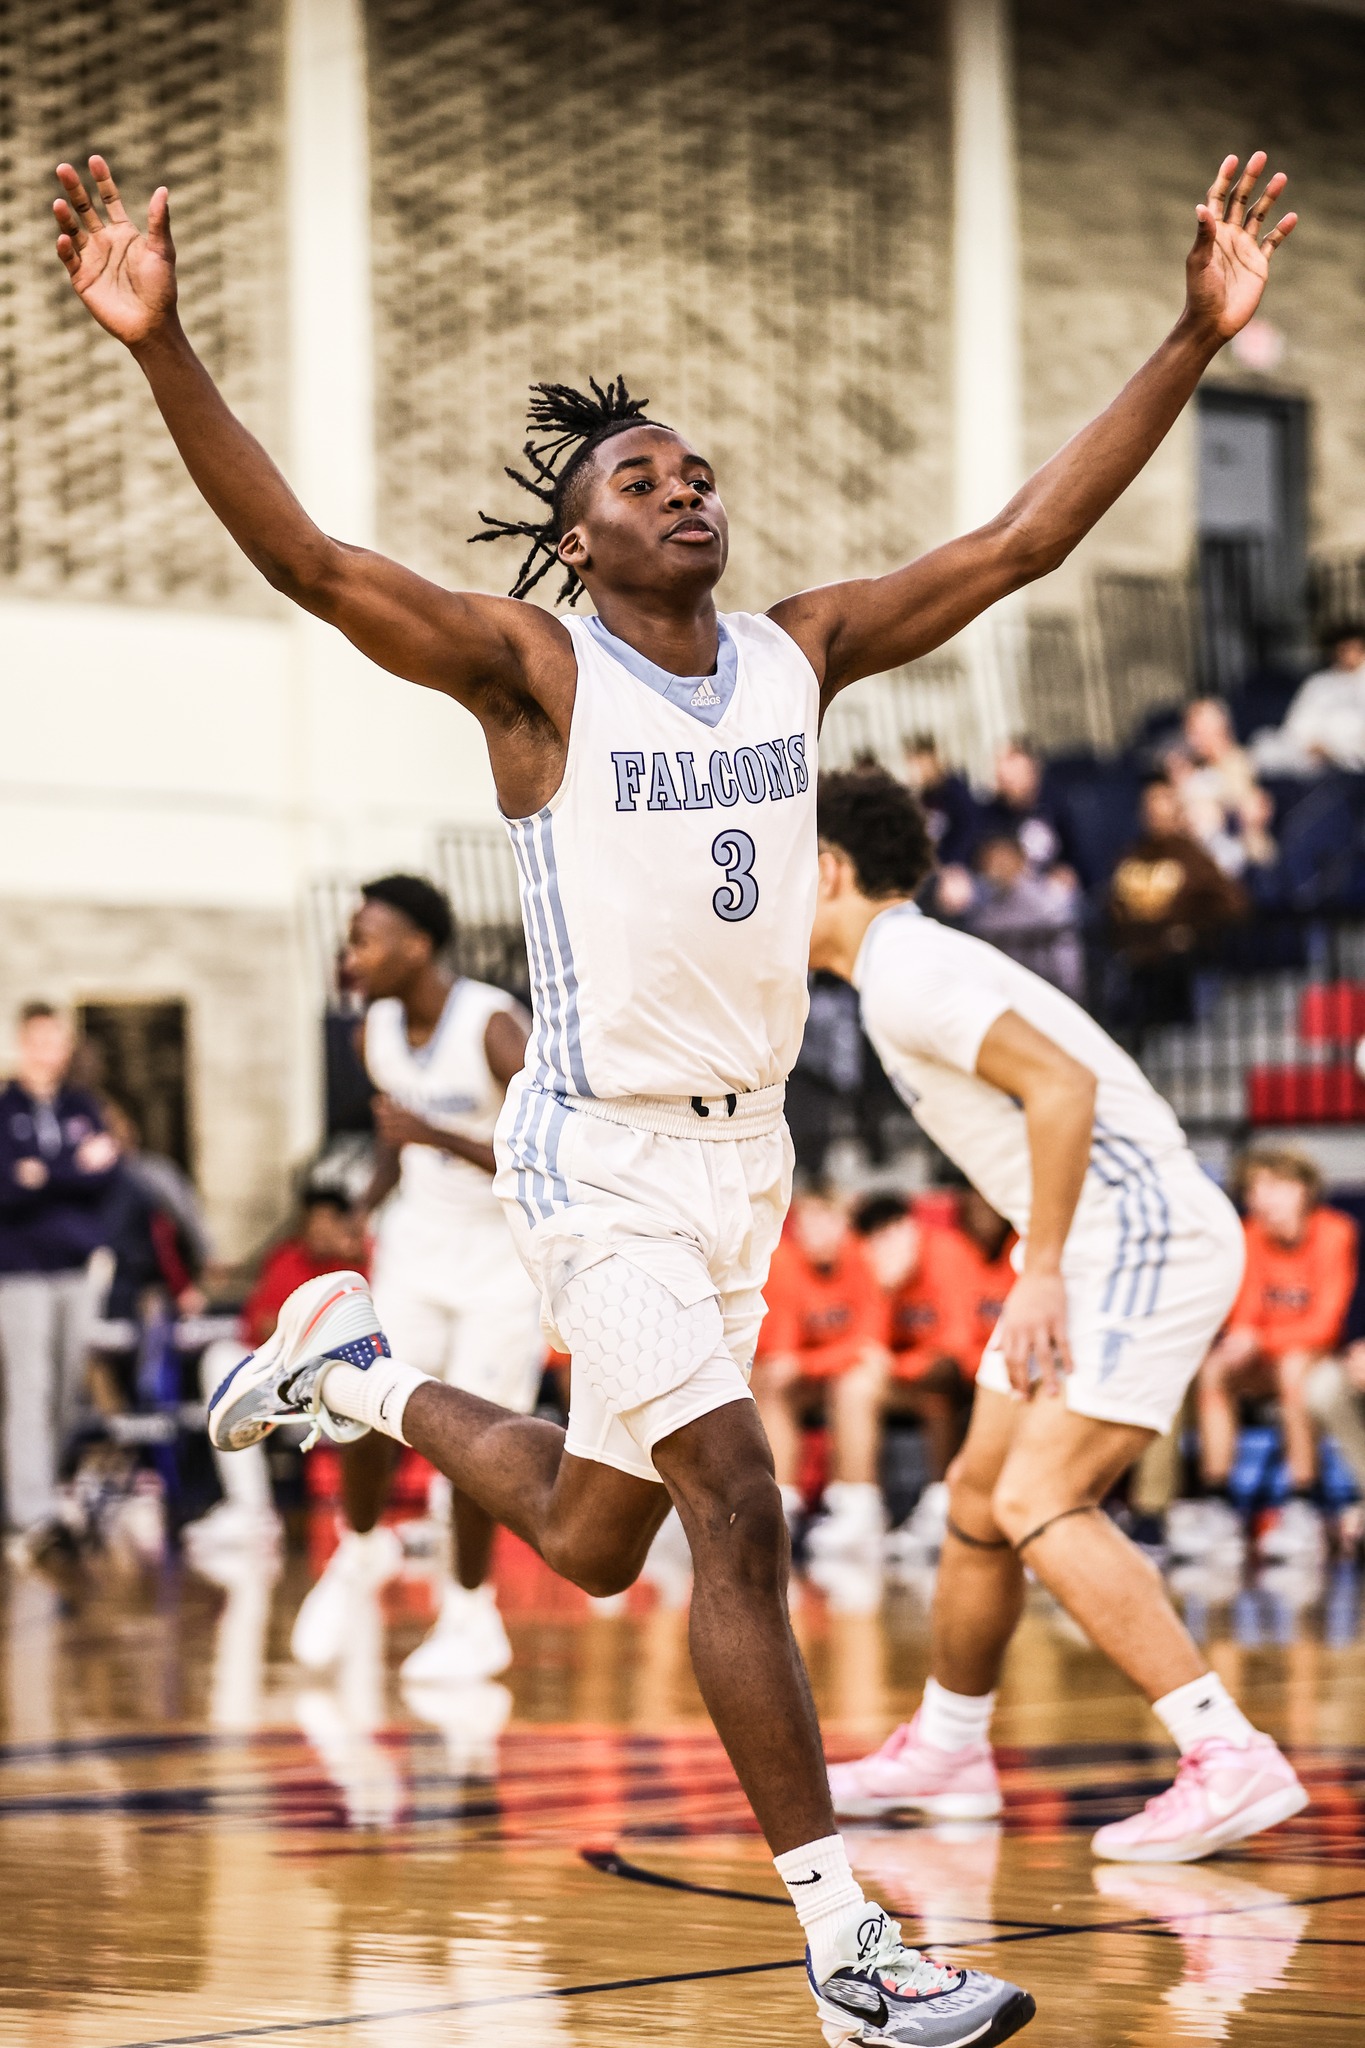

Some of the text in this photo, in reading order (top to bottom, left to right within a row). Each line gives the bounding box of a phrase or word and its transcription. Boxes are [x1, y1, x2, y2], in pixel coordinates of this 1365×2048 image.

[690, 694, 721, 707] adidas
[611, 733, 808, 811] FALCONS
[711, 829, 759, 922] 3
